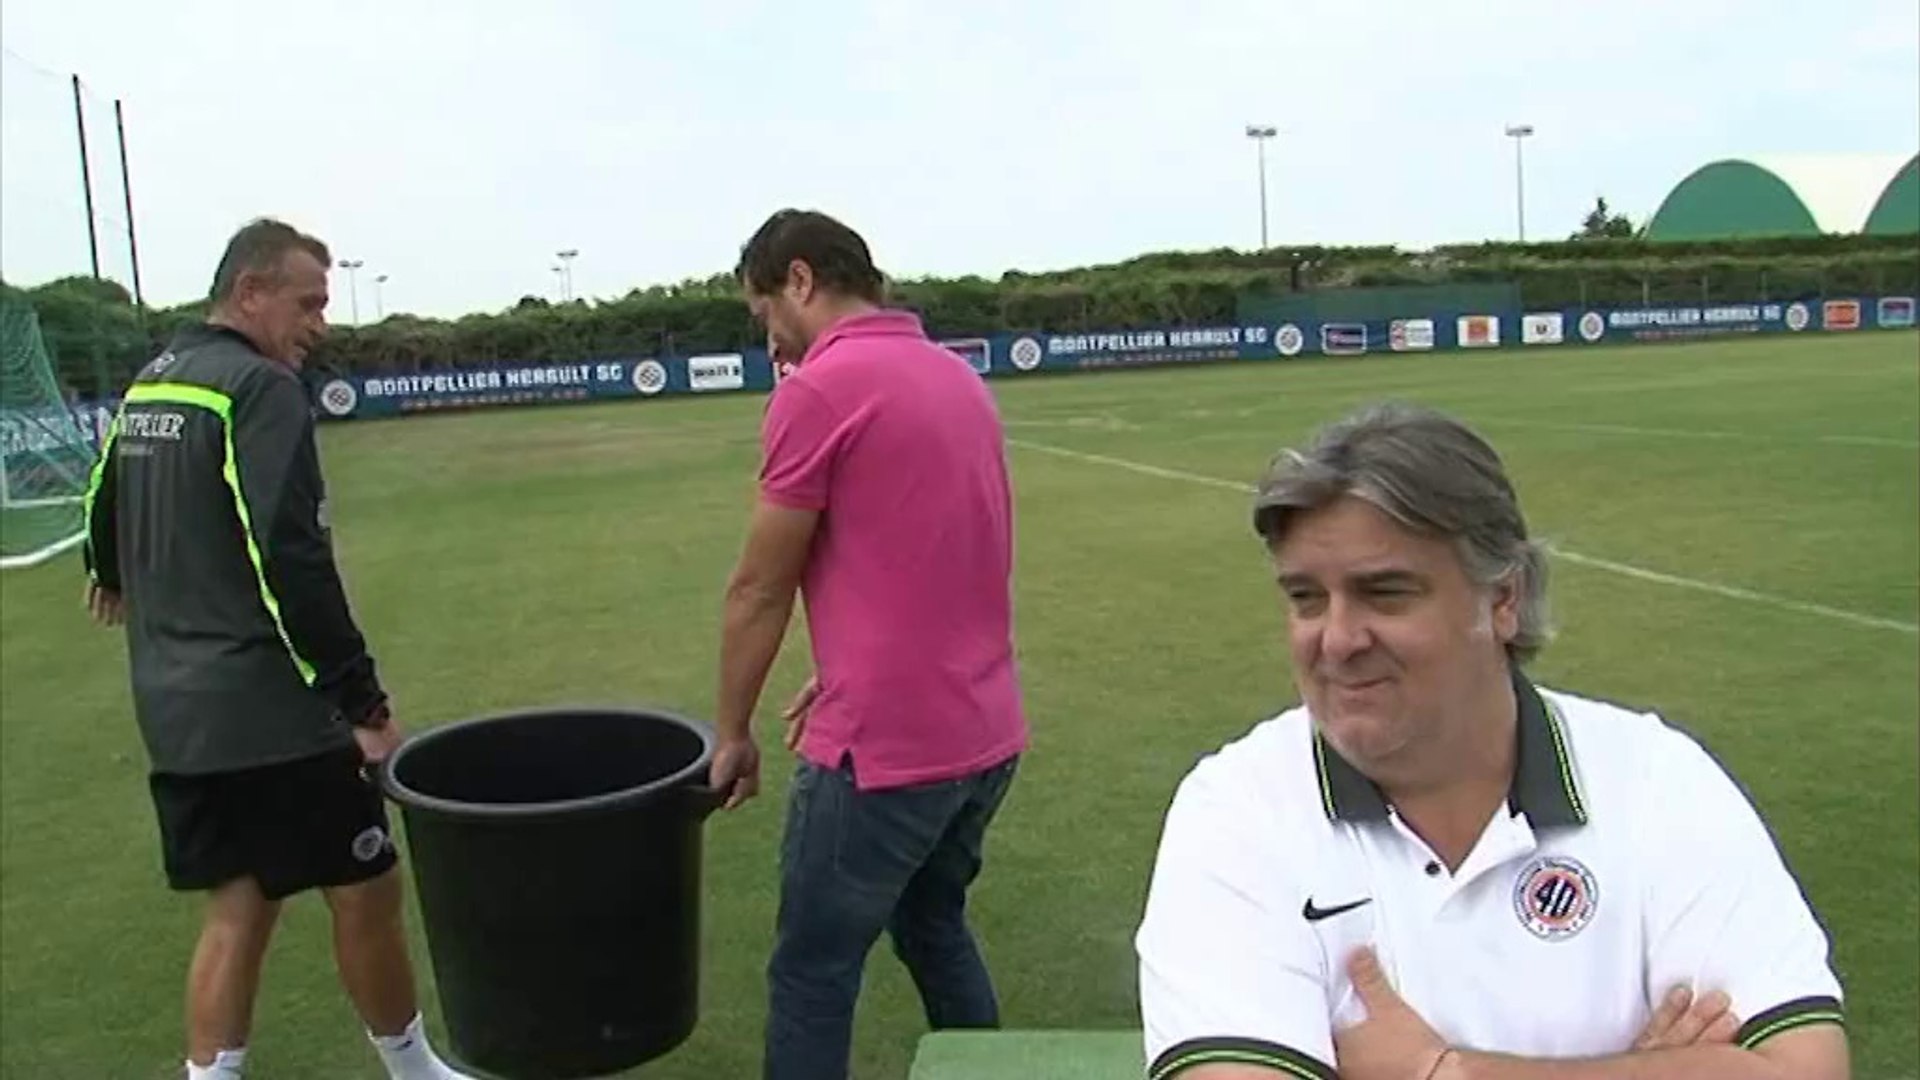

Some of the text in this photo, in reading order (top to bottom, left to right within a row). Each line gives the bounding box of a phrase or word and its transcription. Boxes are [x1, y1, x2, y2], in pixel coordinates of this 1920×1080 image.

[1049, 332, 1165, 354] MONTPELLIER
[1170, 329, 1241, 347] HERAULT
[364, 371, 500, 396] MONTPELLIER
[506, 364, 591, 387] HERAULT
